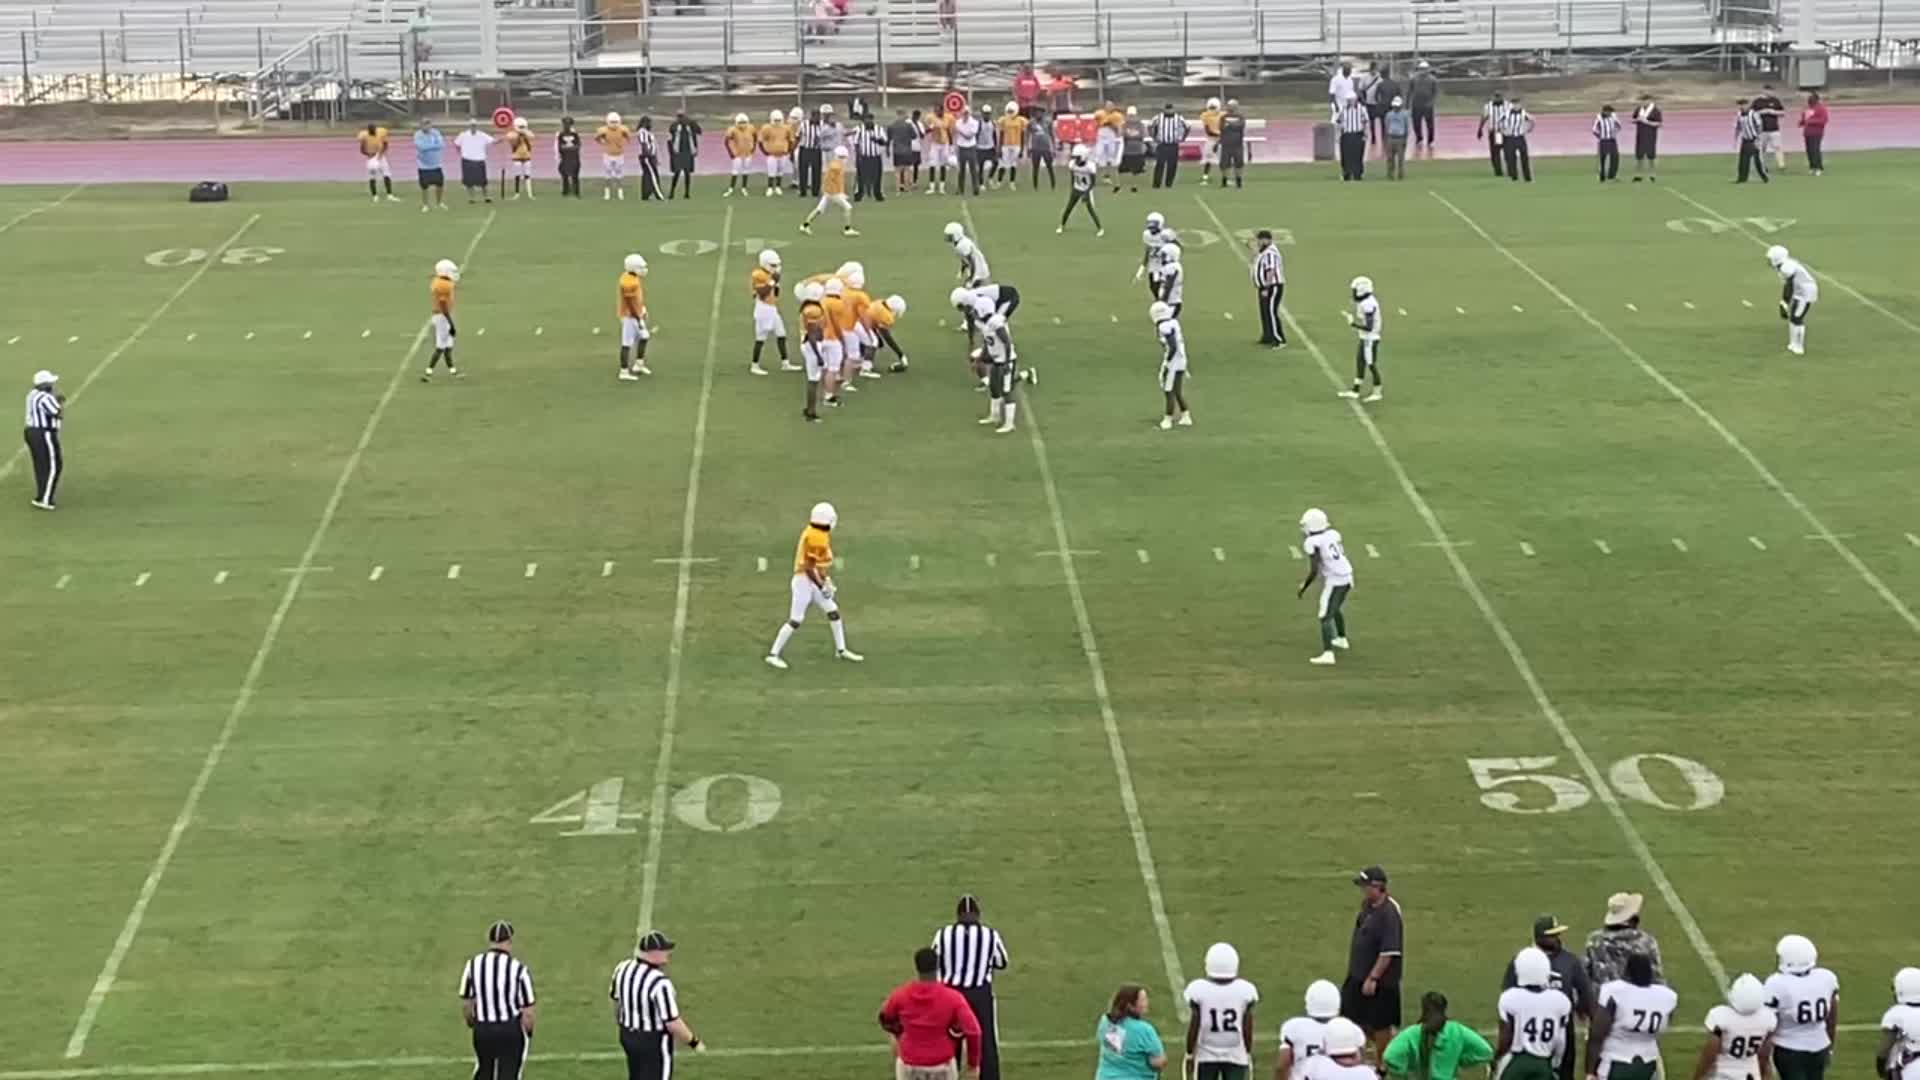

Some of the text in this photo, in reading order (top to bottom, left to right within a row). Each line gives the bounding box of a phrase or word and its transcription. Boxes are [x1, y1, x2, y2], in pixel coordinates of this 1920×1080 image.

[1466, 753, 1725, 814] 50
[529, 773, 783, 836] 40
[1209, 1007, 1239, 1033] 12
[1632, 1008, 1663, 1034] 70
[1796, 997, 1827, 1024] 60
[1522, 1016, 1556, 1043] 48
[1728, 1035, 1763, 1059] 85
